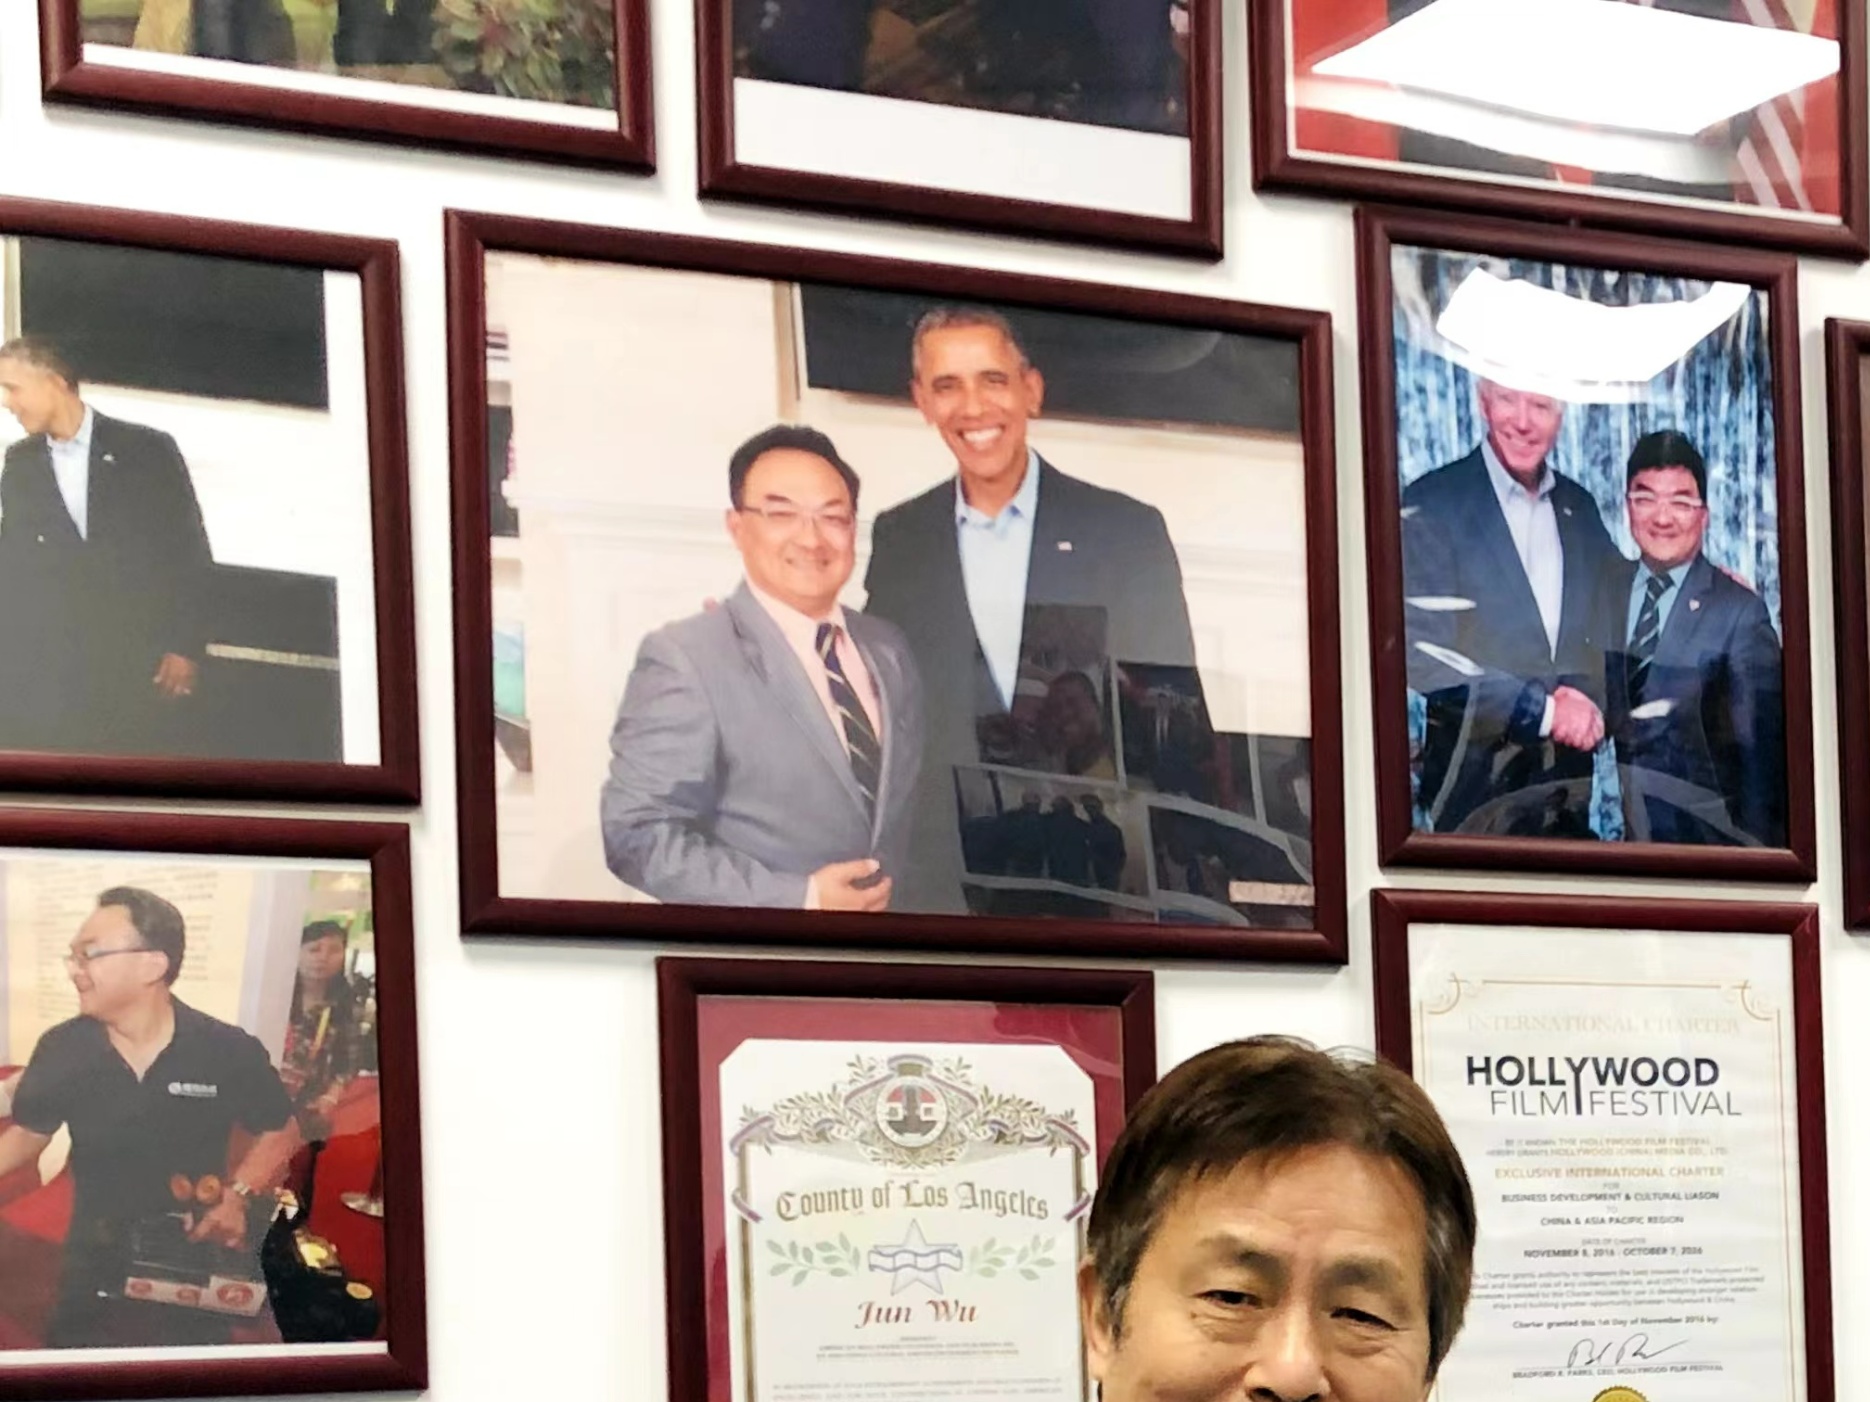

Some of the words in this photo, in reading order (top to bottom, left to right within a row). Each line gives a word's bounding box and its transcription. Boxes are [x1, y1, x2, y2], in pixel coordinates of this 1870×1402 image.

[1466, 1055, 1719, 1115] HOLLYWOOD
[1491, 1090, 1568, 1116] FILM
[1590, 1090, 1742, 1116] FESTIVAL
[1494, 1168, 1561, 1178] EXCLUSIVE
[1566, 1167, 1665, 1178] INTERNATIONAL
[1669, 1167, 1725, 1177] CHARTER
[776, 1187, 864, 1221] County
[871, 1181, 895, 1208] of
[901, 1180, 949, 1208] Los
[955, 1181, 1049, 1220] Angeles
[1523, 1249, 1579, 1258] NOVEMBER
[1622, 1248, 1668, 1256] OCTOBER
[854, 1300, 911, 1329] Jun
[926, 1299, 977, 1322] Wu
